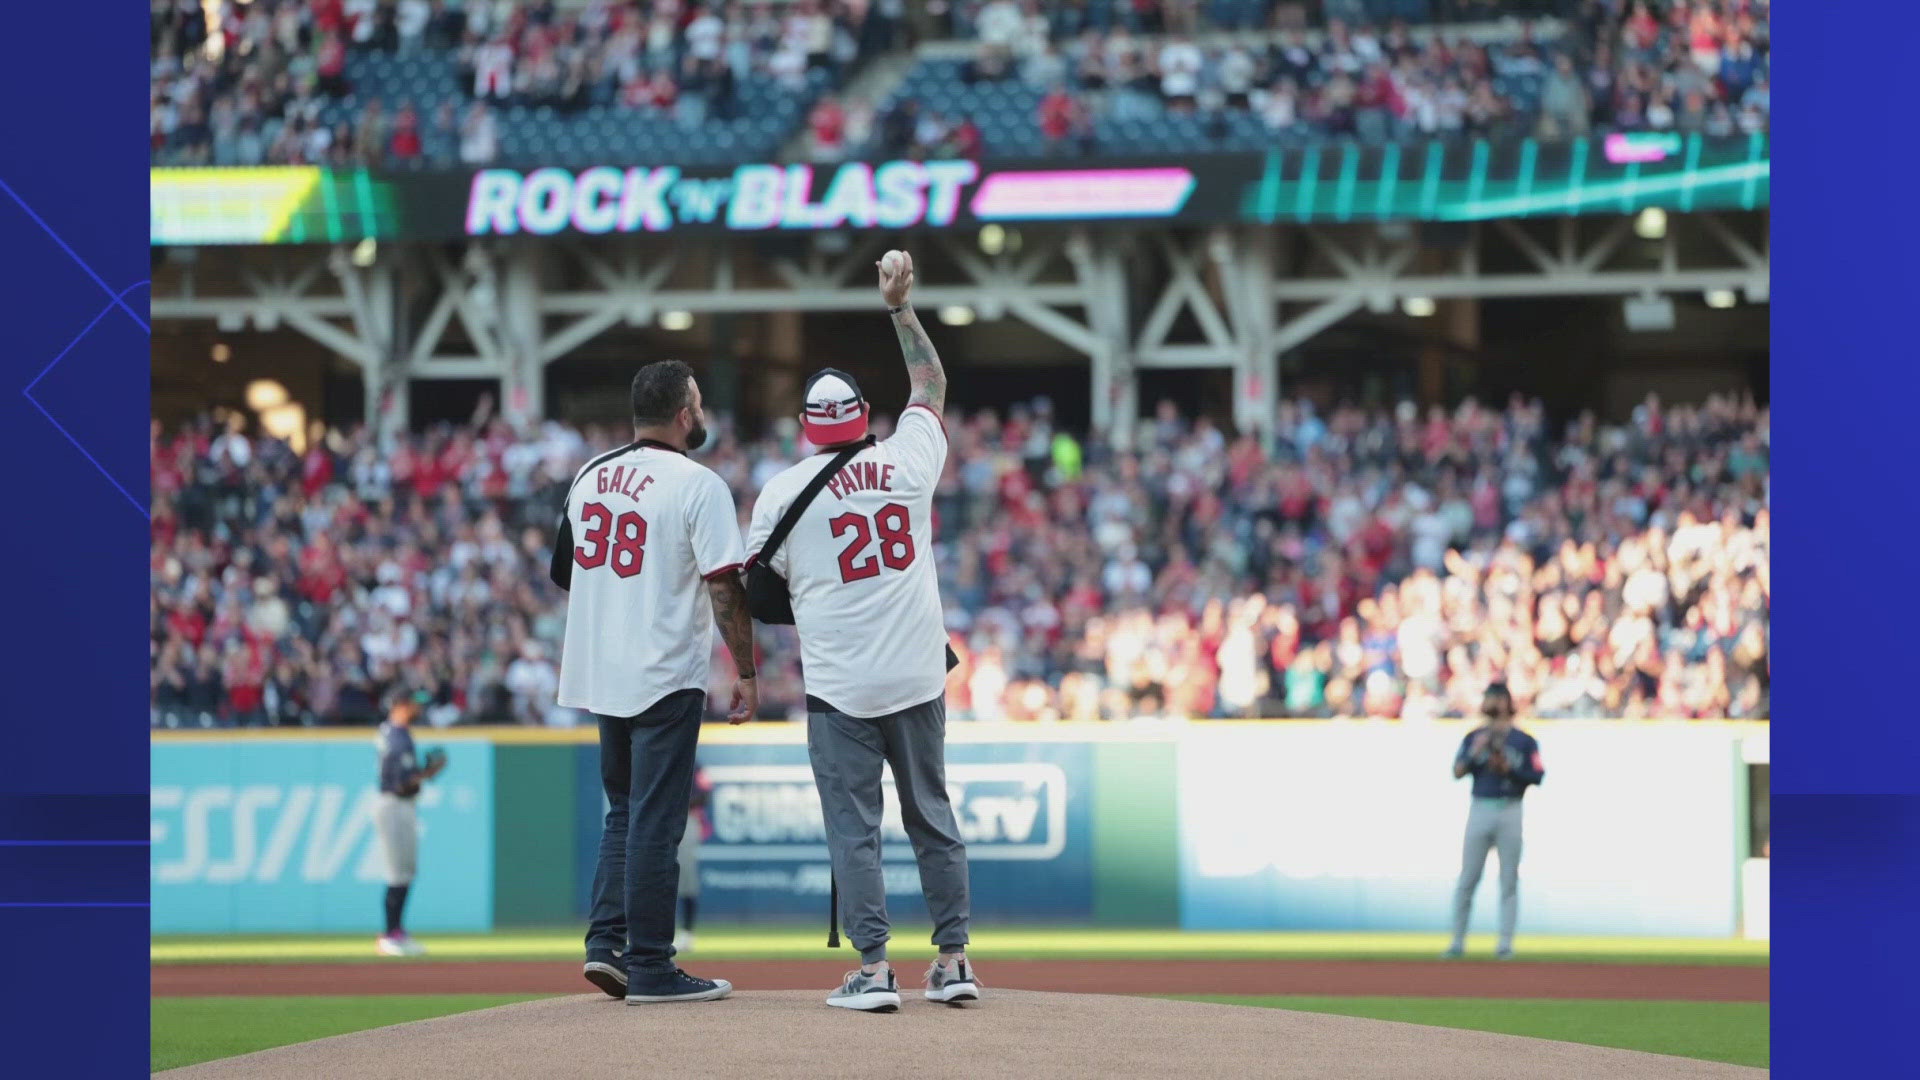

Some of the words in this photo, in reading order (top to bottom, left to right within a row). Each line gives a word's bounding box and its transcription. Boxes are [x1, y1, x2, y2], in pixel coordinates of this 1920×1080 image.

[465, 165, 681, 235] ROCK
[726, 159, 978, 230] BLAST
[597, 465, 655, 503] GALE
[826, 461, 895, 501] PAYNE
[574, 501, 648, 579] 38
[828, 502, 916, 584] 28
